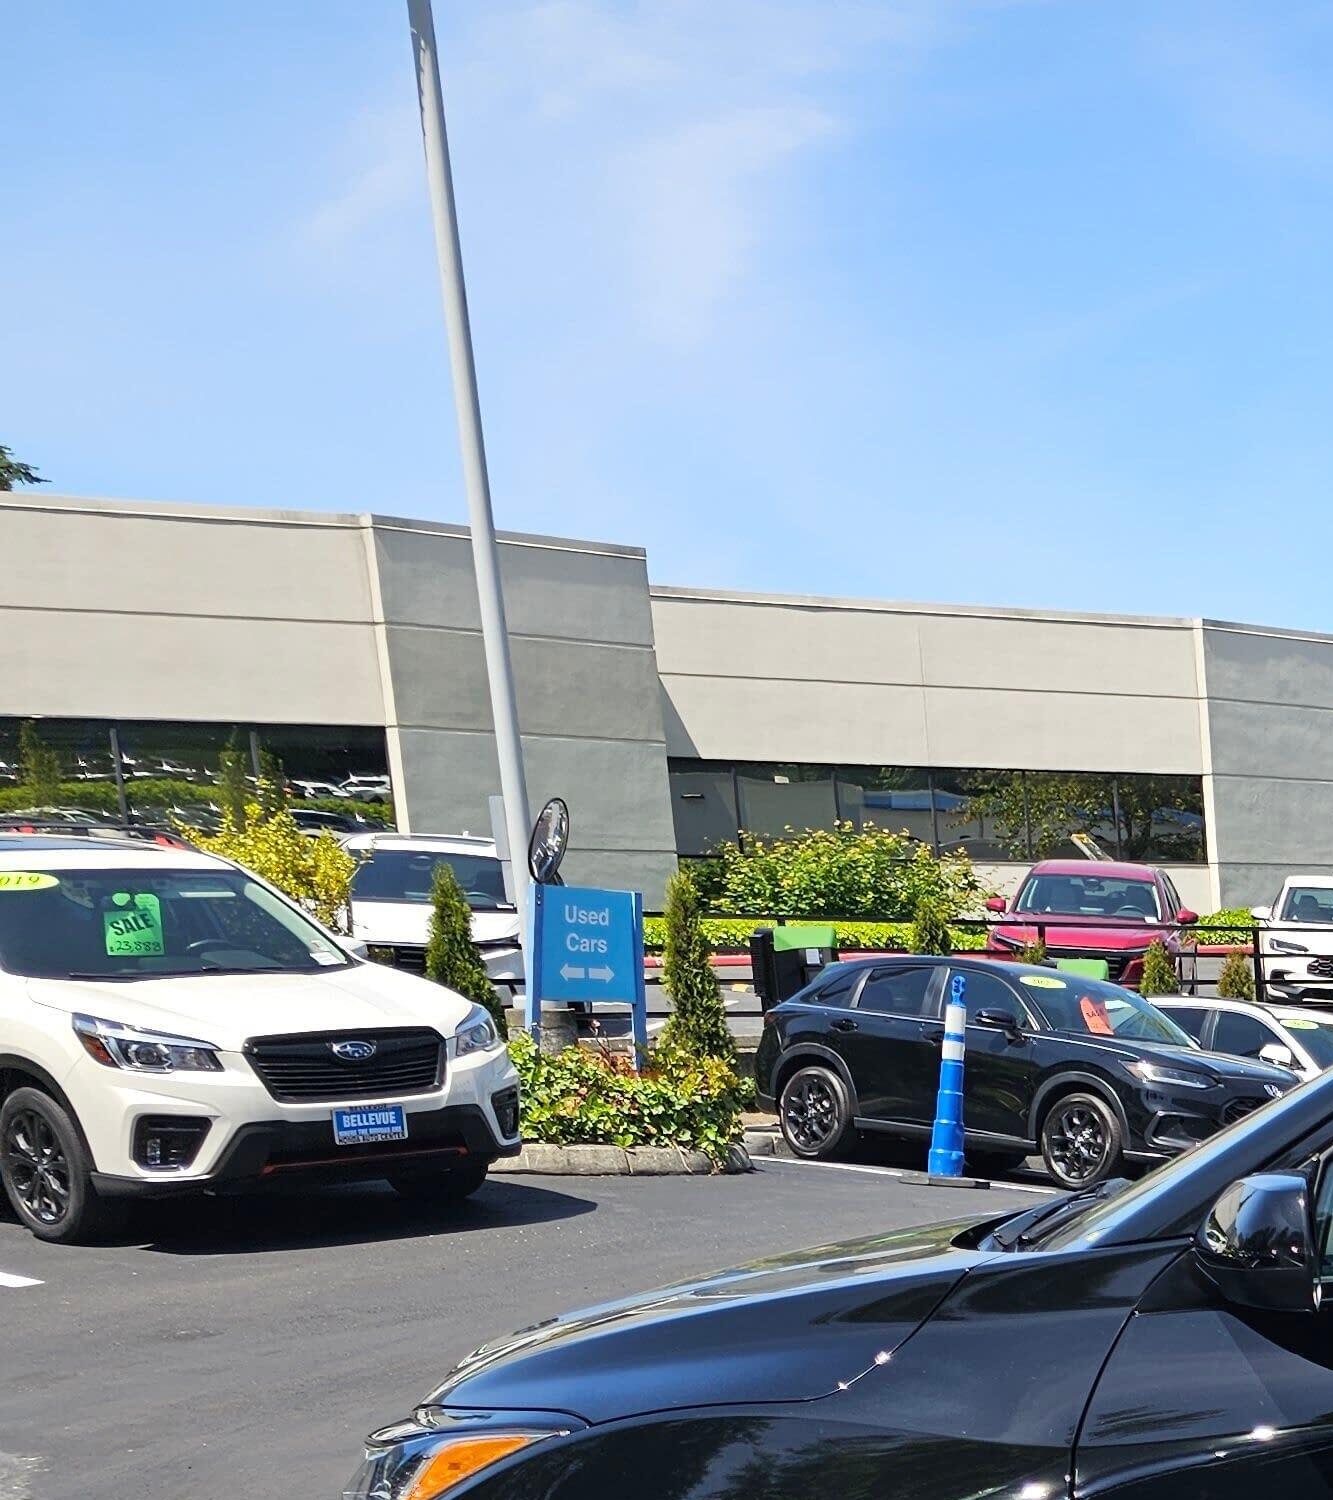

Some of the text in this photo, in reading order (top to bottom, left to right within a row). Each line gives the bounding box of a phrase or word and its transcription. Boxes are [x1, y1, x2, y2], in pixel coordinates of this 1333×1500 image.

[110, 912, 154, 936] SALE
[564, 904, 609, 926] Used
[566, 932, 608, 953] Cars
[342, 1111, 397, 1128] BELLEVUE
